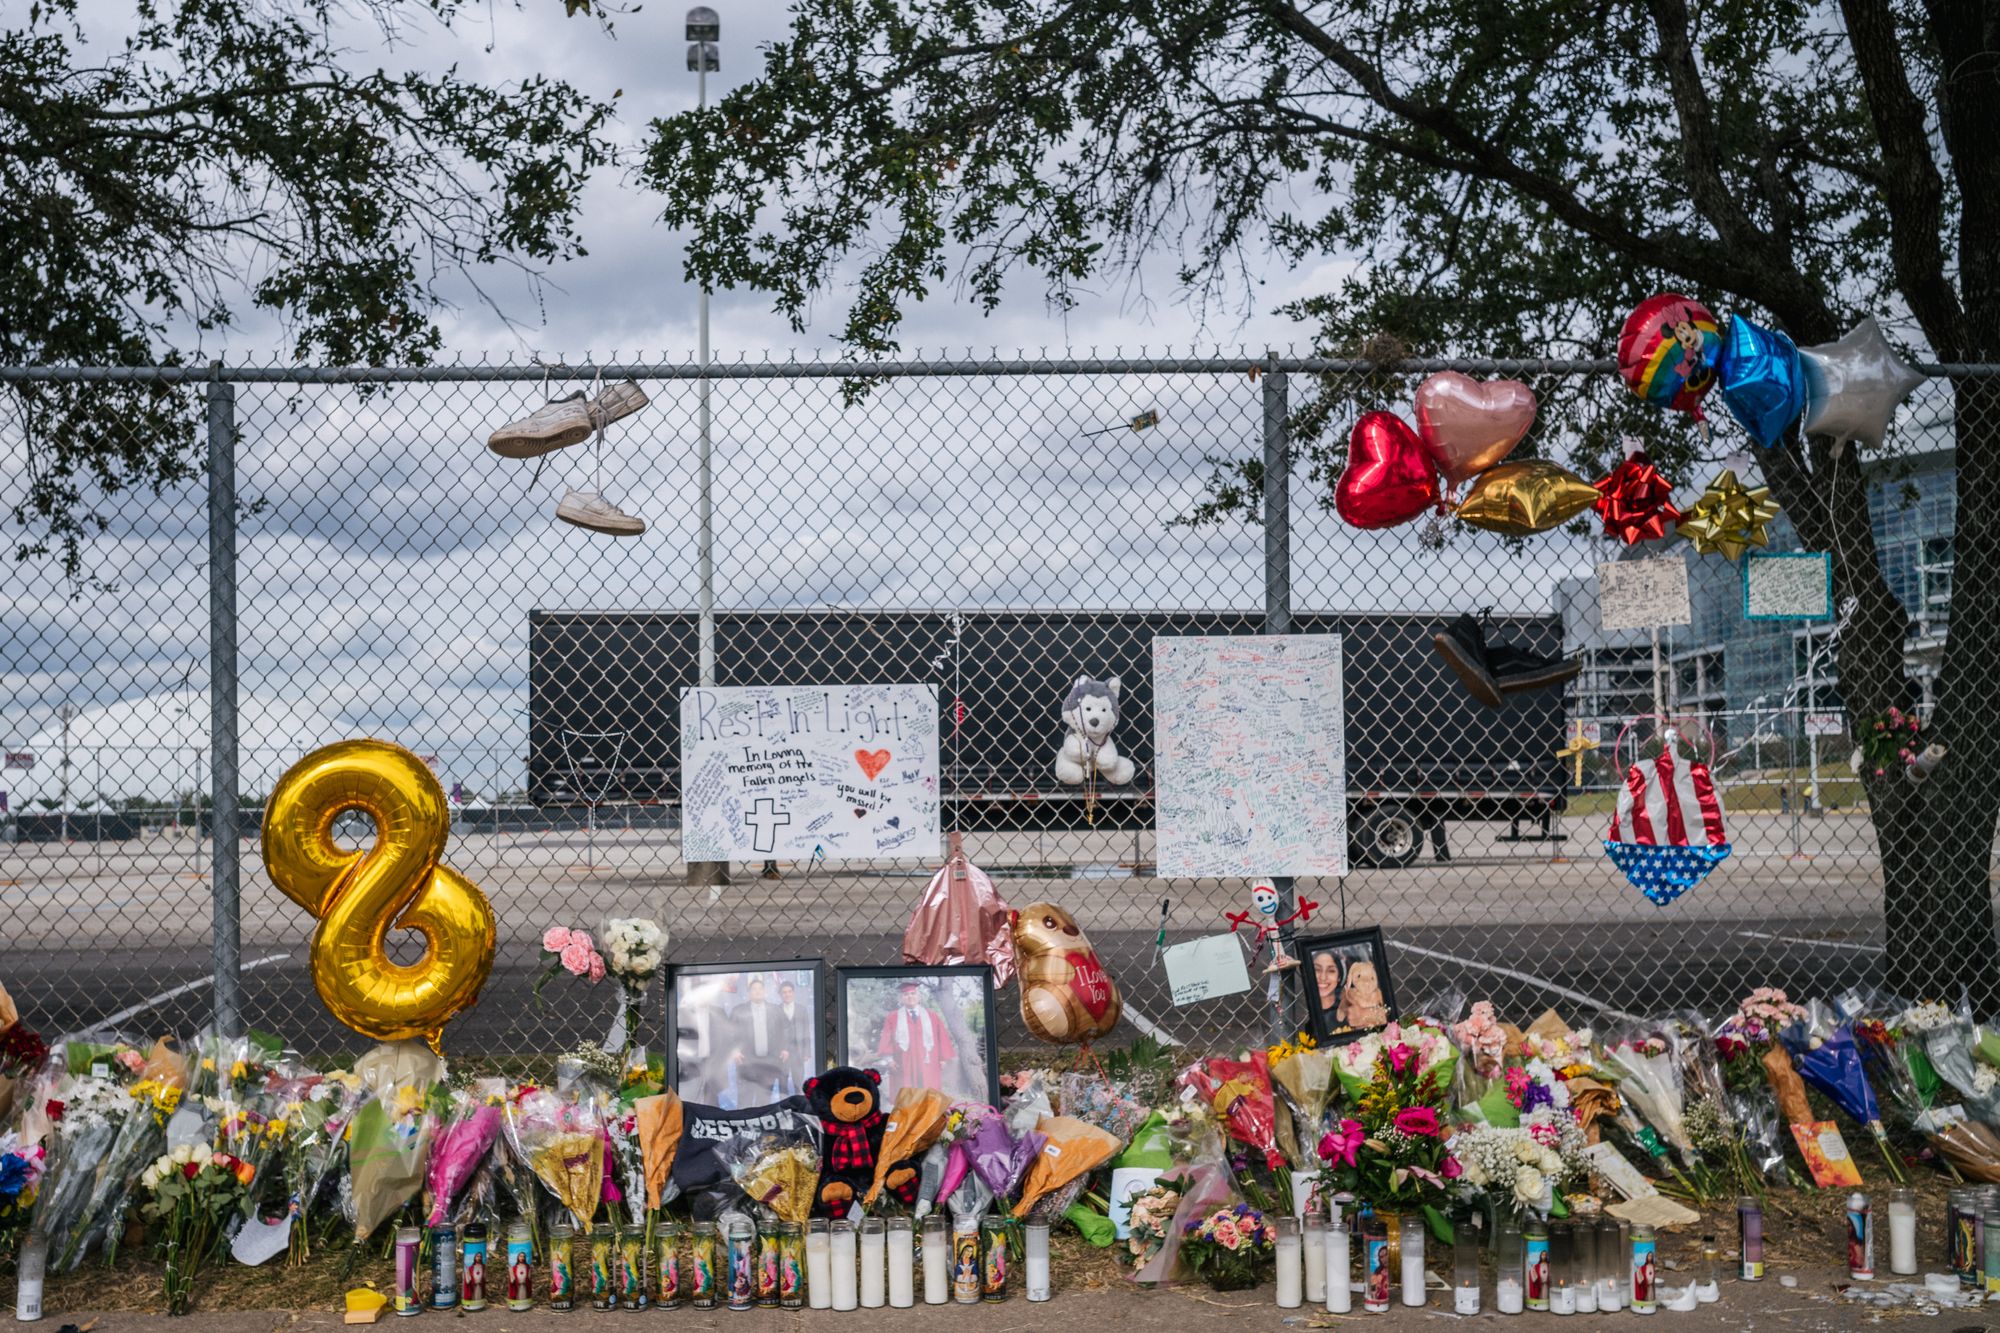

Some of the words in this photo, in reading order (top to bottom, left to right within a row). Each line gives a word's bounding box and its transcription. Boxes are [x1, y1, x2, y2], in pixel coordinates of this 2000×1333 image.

[697, 690, 775, 741] Rest
[786, 697, 811, 735] In
[823, 692, 908, 743] Light
[742, 746, 760, 763] In
[764, 747, 806, 763] Loving
[728, 763, 775, 775] memory
[779, 760, 791, 769] of
[796, 760, 813, 770] the
[743, 775, 776, 787] Fallen
[778, 772, 816, 786] angels
[837, 783, 856, 798] you
[858, 788, 877, 798] will
[880, 791, 892, 803] be
[1075, 965, 1085, 987] I
[1083, 964, 1108, 985] Love
[1088, 985, 1106, 1003] You
